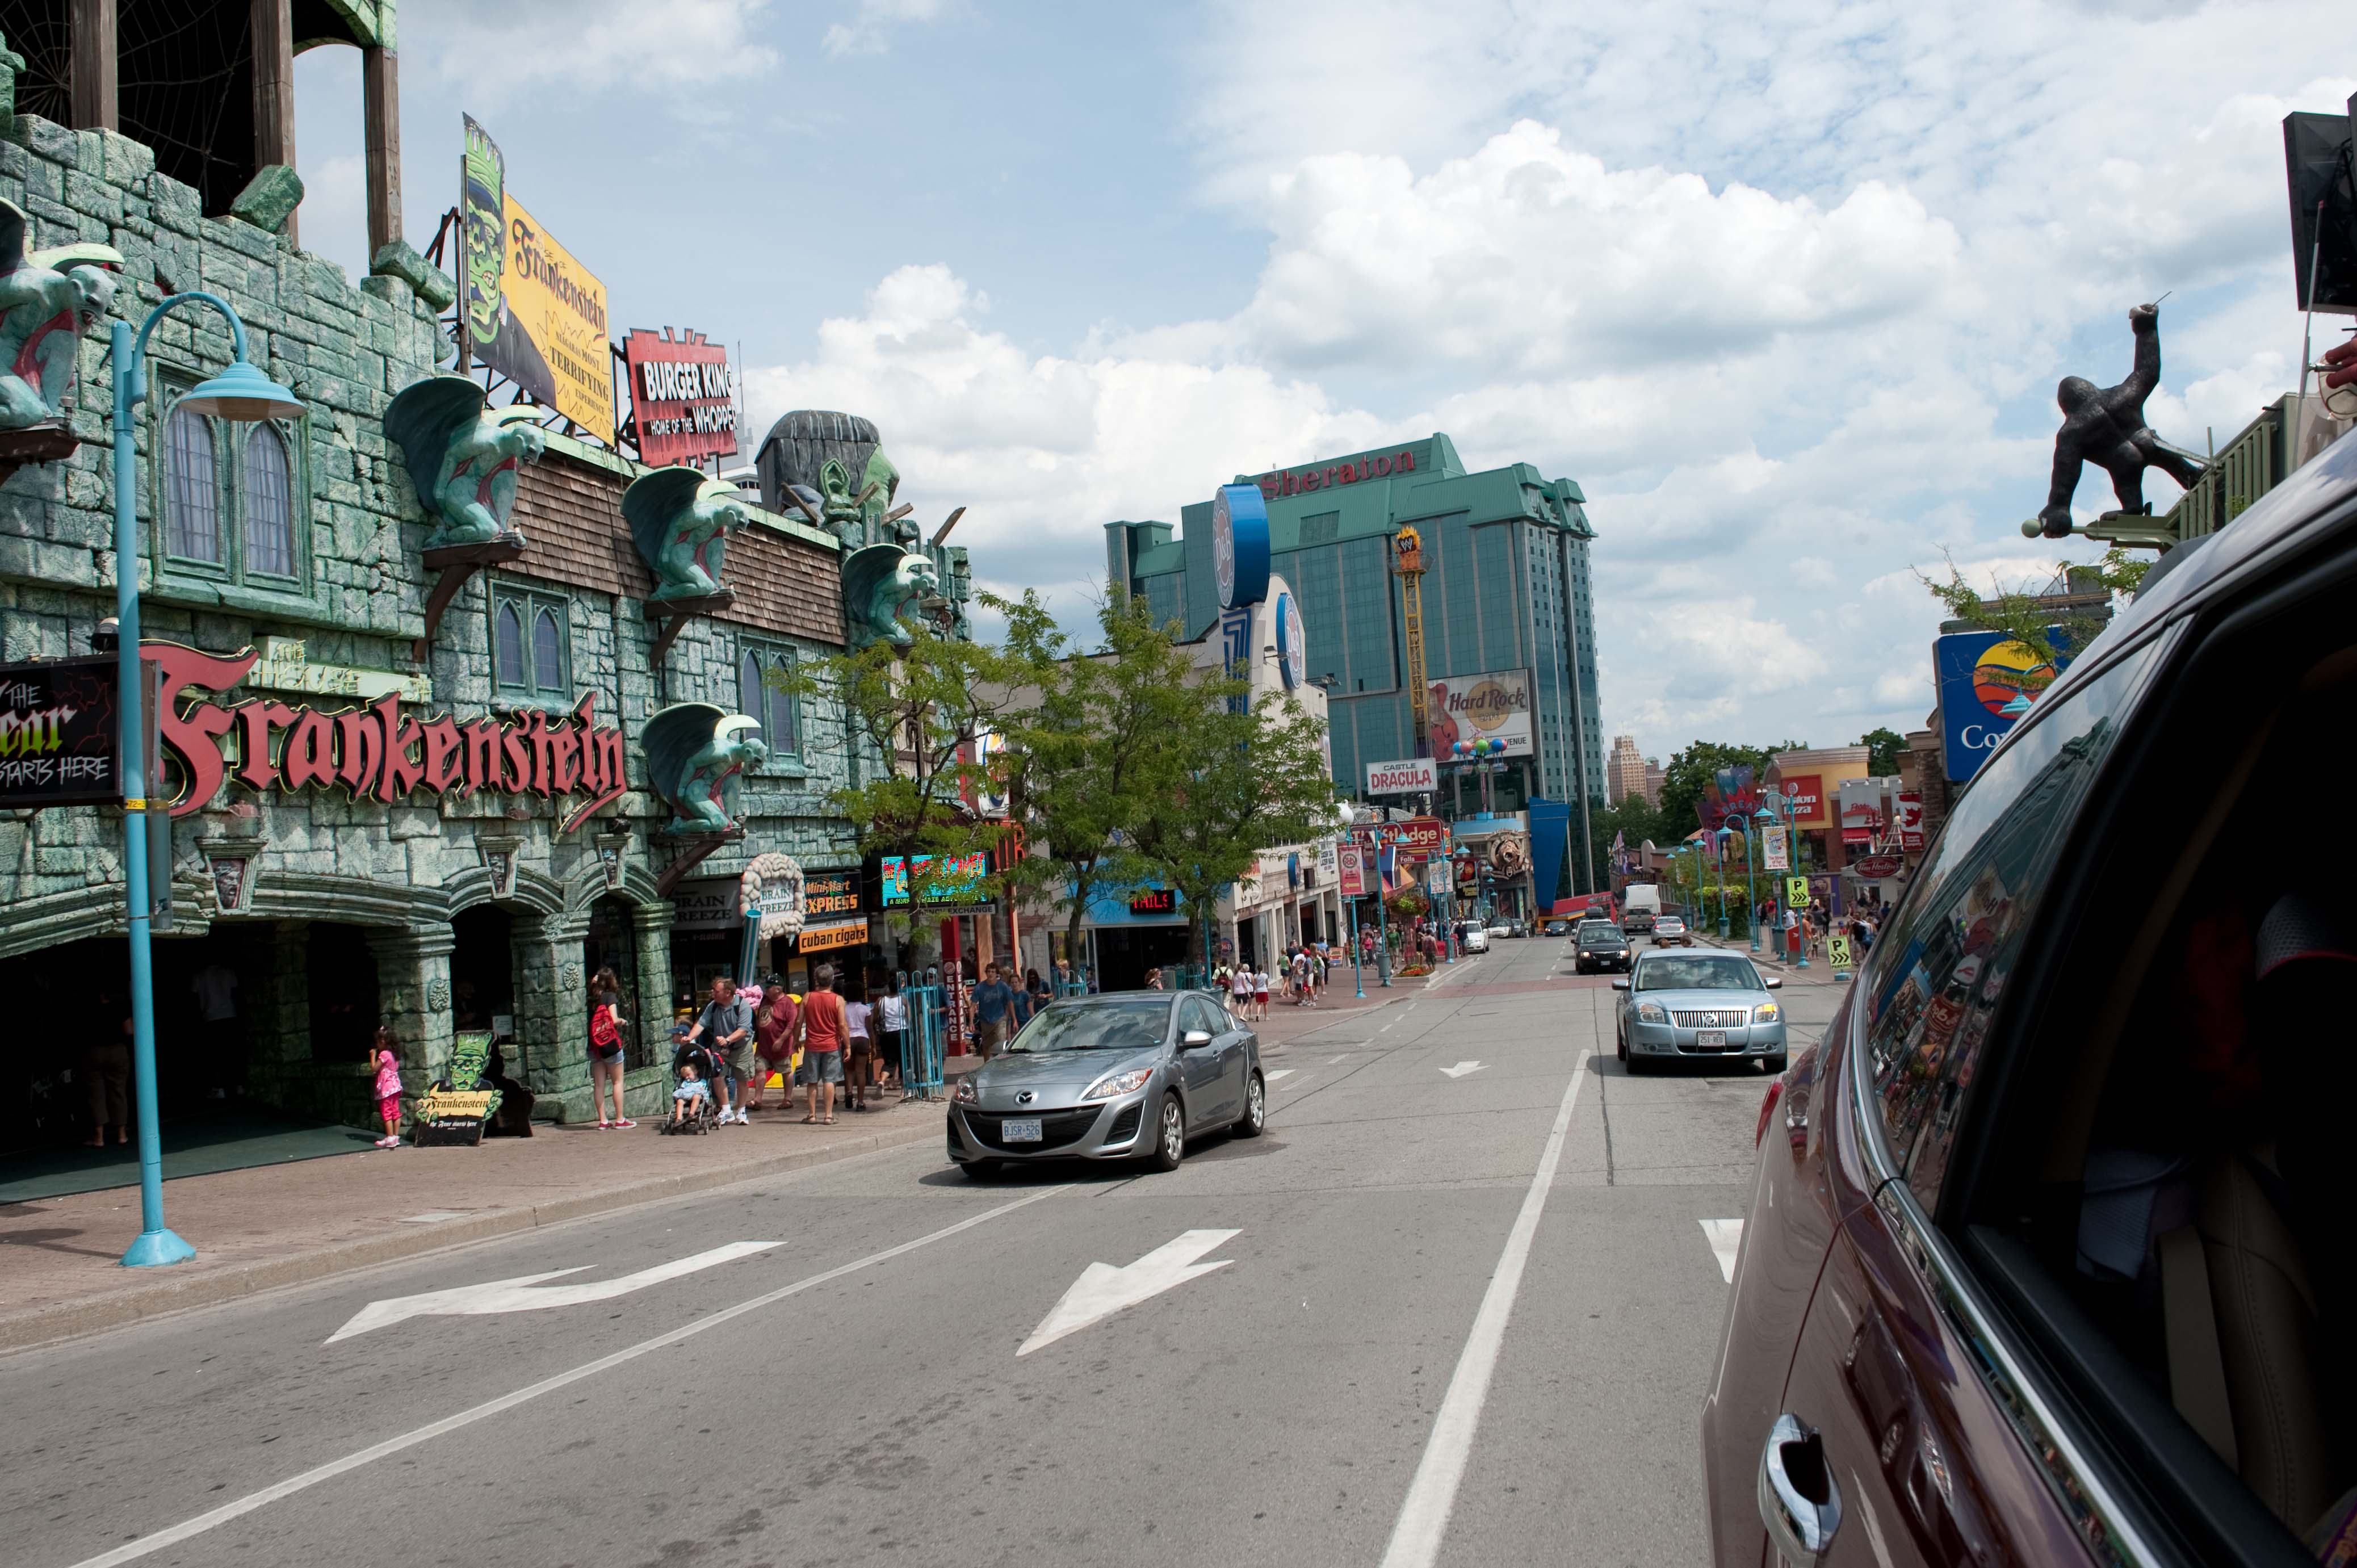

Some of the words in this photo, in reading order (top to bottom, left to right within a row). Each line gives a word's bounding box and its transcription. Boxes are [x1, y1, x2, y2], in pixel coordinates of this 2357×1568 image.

[513, 219, 605, 342] Frankenstein
[582, 349, 600, 371] MOST
[550, 346, 609, 401] TERRIFYING
[643, 361, 703, 401] BURGER
[702, 362, 735, 398] KING
[576, 389, 605, 416] EXPERIENCE
[650, 419, 670, 435] HOME
[672, 418, 681, 434] OF
[681, 418, 694, 433] THE
[692, 404, 738, 434] WHOPPER
[1260, 451, 1415, 499] Sheraton
[1215, 527, 1232, 572] D&B
[1286, 626, 1301, 657] D&B
[6, 683, 43, 708] THE
[1449, 690, 1486, 711] Hard
[1489, 687, 1526, 710] Rock
[0, 705, 78, 758] ear
[139, 640, 626, 833] Frankenstein
[1507, 737, 1527, 746] VENUE
[57, 756, 110, 785] HERE
[1371, 769, 1432, 790] DRACULA
[1857, 862, 1872, 871] Tim
[761, 888, 790, 900] BRAIN
[806, 880, 850, 894] Mini-Mart
[1794, 881, 1802, 891] P
[677, 909, 732, 923] REEZE
[760, 902, 794, 914] FREEZE
[948, 905, 993, 915] EXCHANGE
[802, 933, 833, 948] cuban
[836, 929, 866, 945] cigars
[1832, 940, 1842, 951] P
[946, 975, 958, 1041] ENTRANCE
[426, 1096, 489, 1110] Frankenstein
